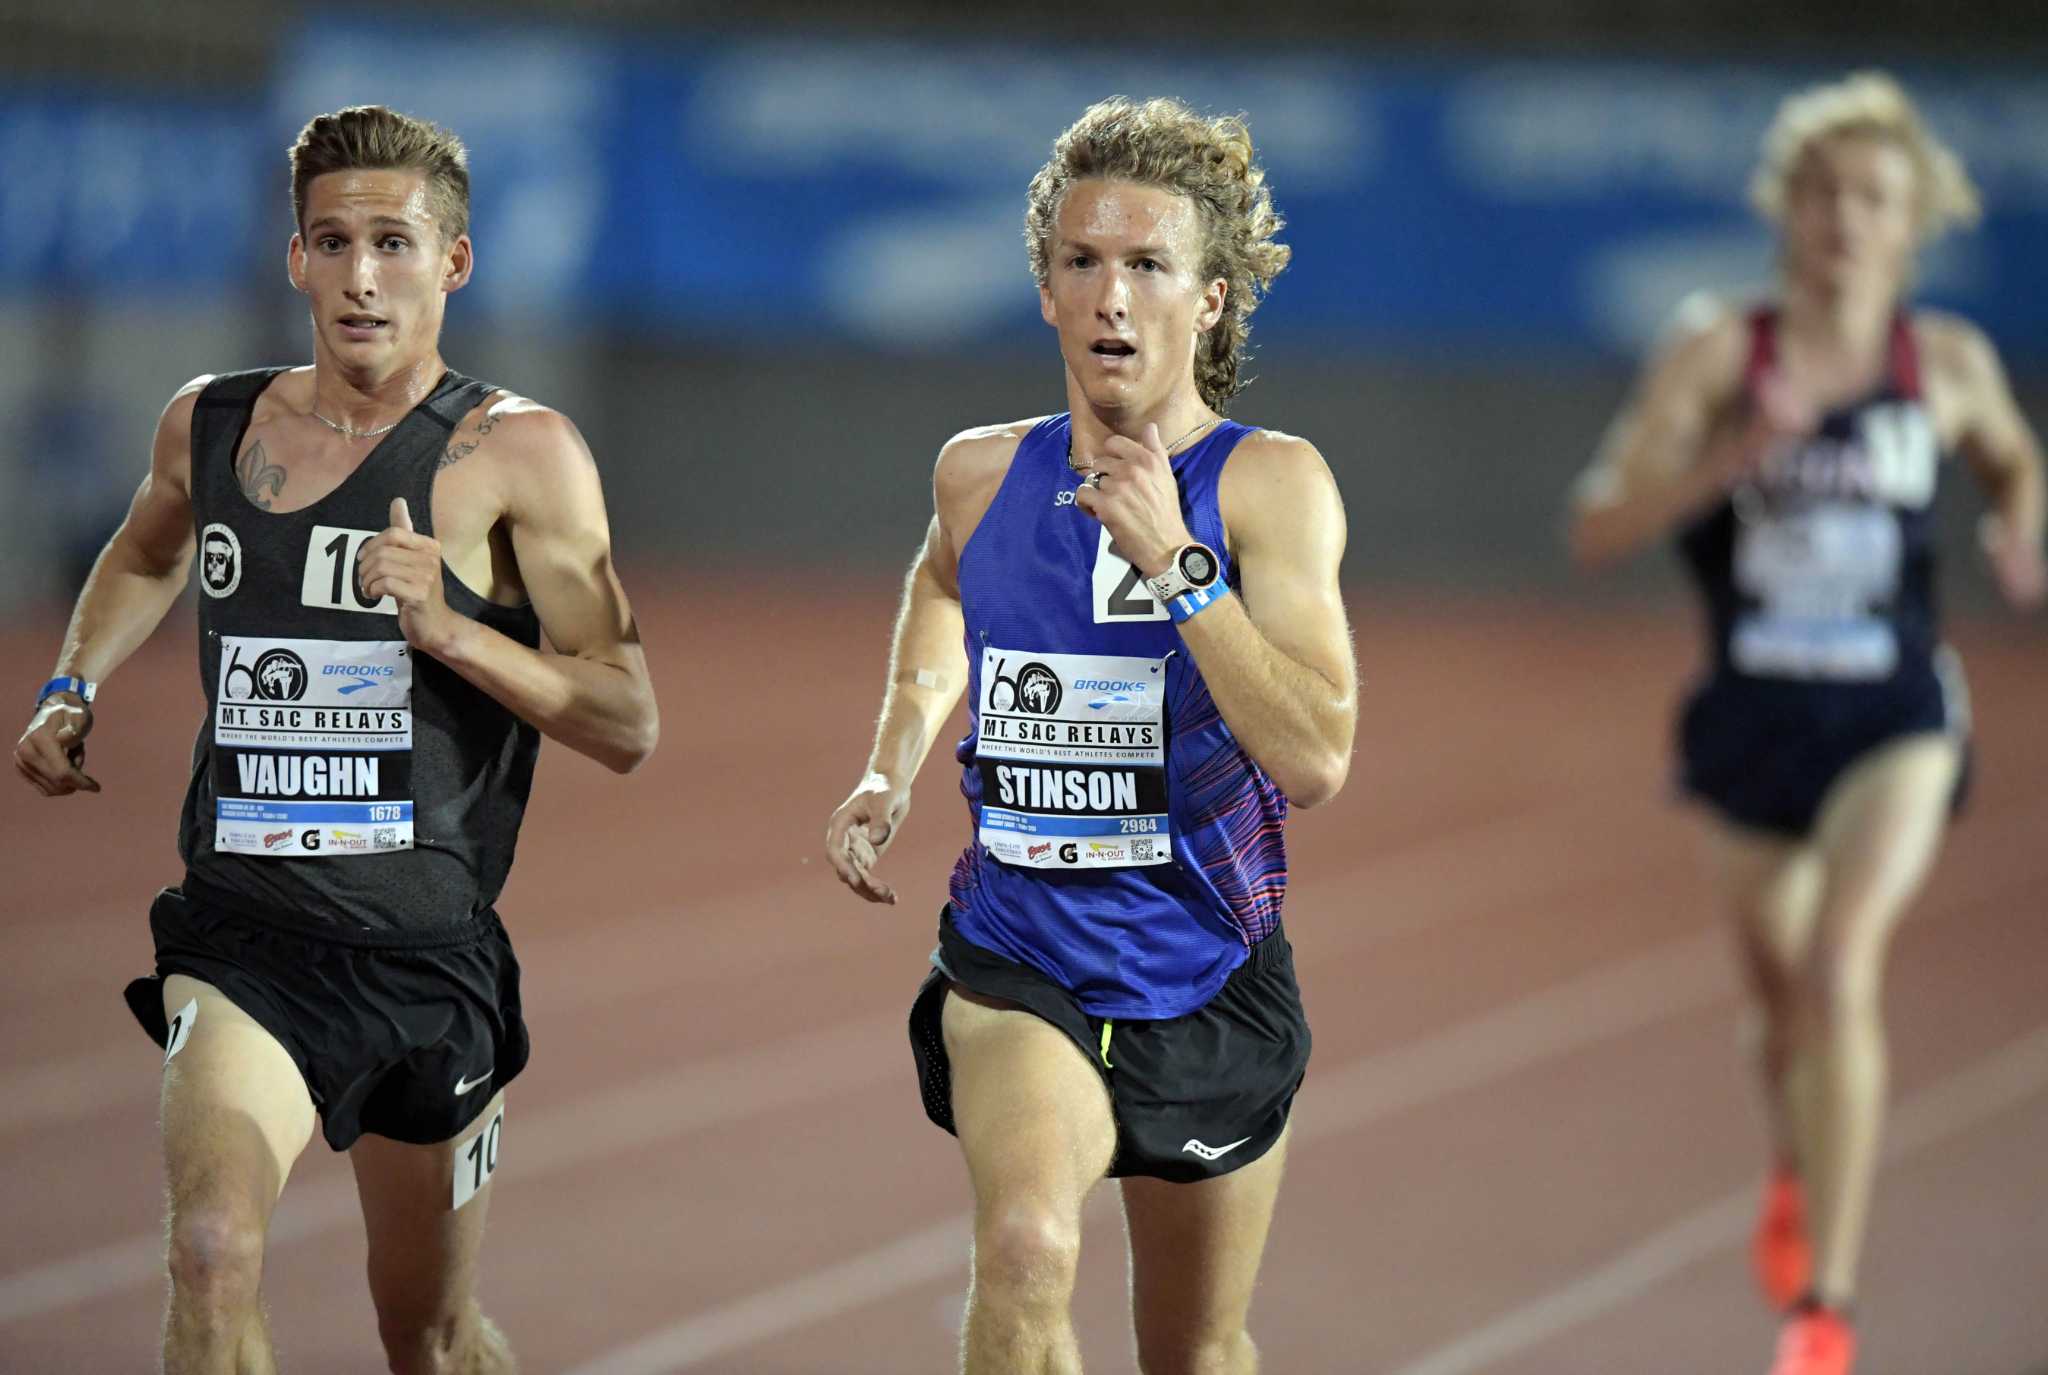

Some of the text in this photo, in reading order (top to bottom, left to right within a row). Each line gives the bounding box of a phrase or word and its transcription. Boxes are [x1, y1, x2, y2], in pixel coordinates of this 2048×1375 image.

[322, 664, 394, 676] BROOKS
[1074, 680, 1147, 692] BROOKS
[222, 707, 403, 729] MT. SAC RELAYS
[983, 719, 1153, 744] MT. SAC RELAYS
[1075, 750, 1113, 758] ATHLETES
[1116, 751, 1155, 759] COMPETE
[237, 753, 379, 797] VAUGHN
[996, 765, 1138, 811] STINSON
[369, 805, 401, 821] 1678
[1120, 818, 1158, 834] 2984
[301, 829, 320, 850] G
[1059, 843, 1078, 864] G
[467, 1114, 501, 1191] 10
